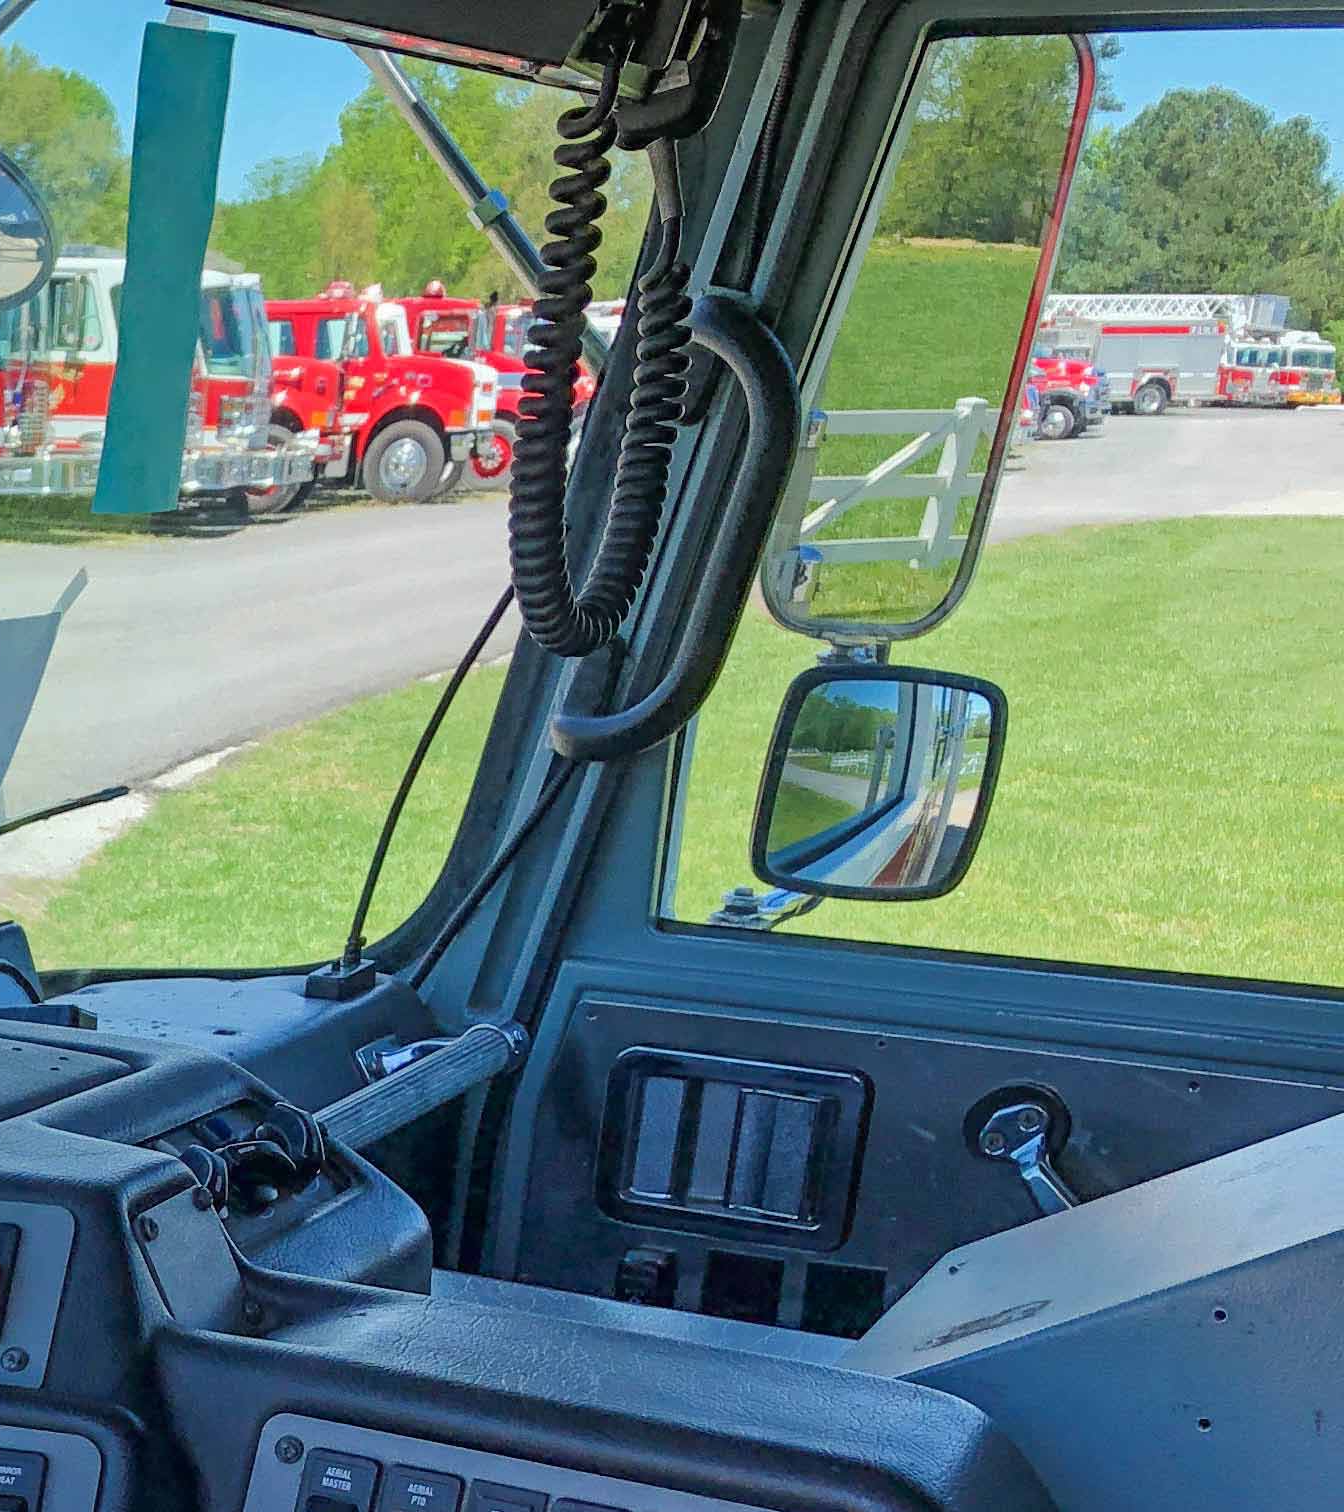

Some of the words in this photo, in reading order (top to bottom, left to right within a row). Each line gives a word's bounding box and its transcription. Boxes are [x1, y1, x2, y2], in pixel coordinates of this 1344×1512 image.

[325, 1466, 352, 1480] AERIAL
[321, 1477, 352, 1491] MASTER
[407, 1484, 433, 1497] AERIAL
[411, 1496, 427, 1507] PTO
